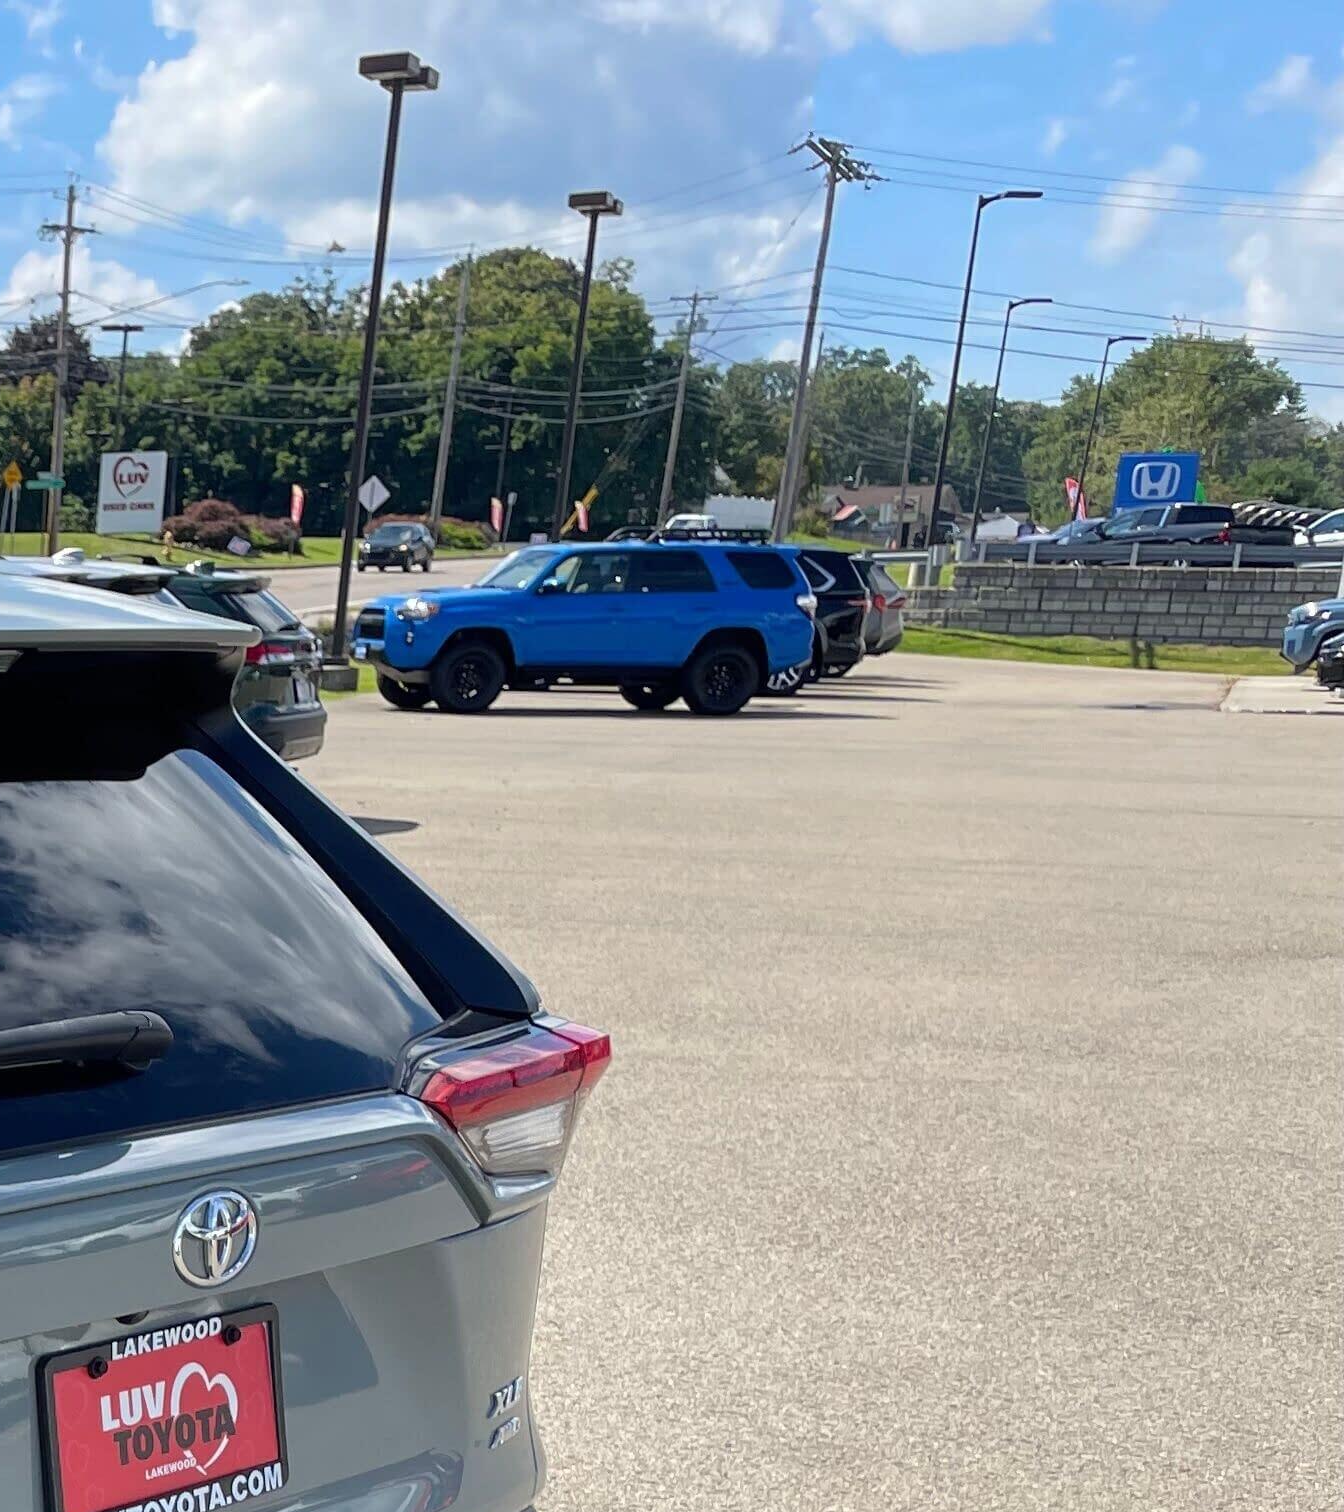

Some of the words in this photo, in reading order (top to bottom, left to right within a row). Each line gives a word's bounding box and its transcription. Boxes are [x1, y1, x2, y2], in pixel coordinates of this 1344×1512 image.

[118, 472, 150, 485] LUV
[111, 1316, 223, 1361] LAKEWOOD
[99, 1380, 166, 1433] LUV
[113, 1404, 236, 1465] TOYOTA
[144, 1457, 197, 1481] LAKEWOOD
